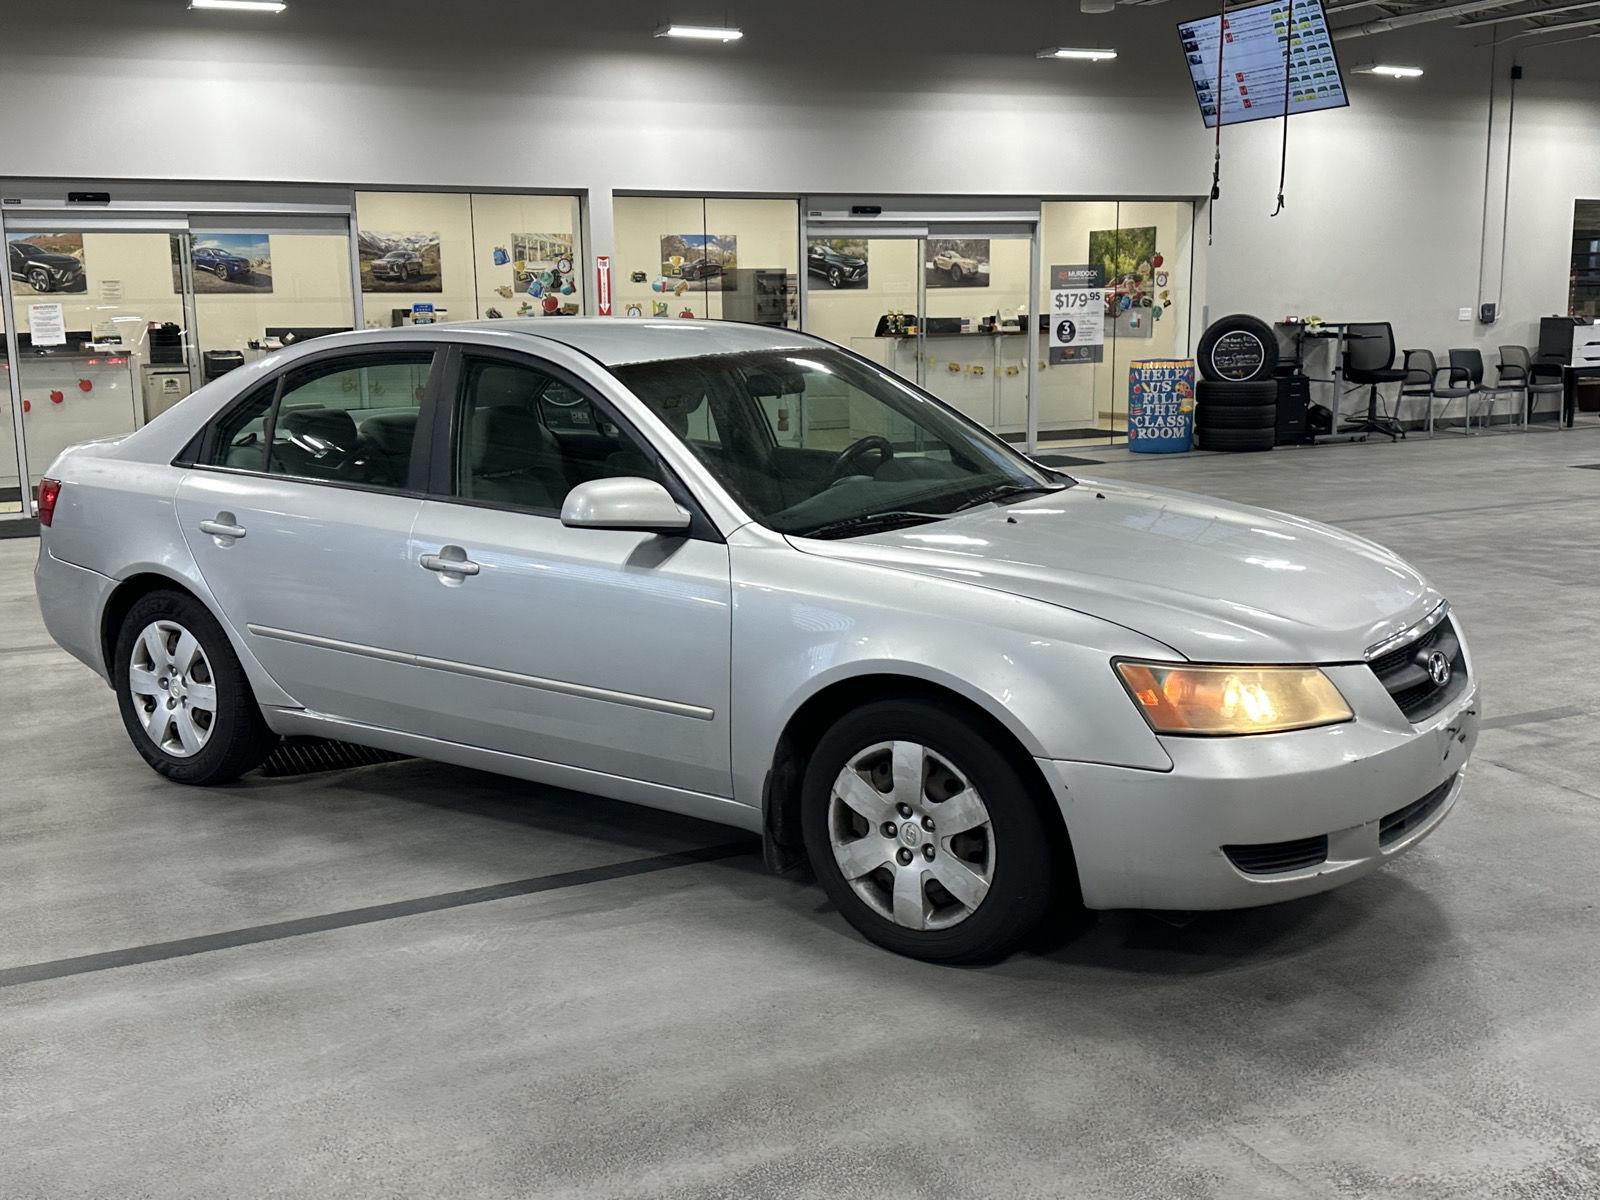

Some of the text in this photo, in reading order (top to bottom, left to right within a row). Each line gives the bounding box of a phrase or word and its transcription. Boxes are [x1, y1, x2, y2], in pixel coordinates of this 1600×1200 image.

[1062, 321, 1070, 335] 3
[1141, 369, 1184, 381] HELP
[1150, 380, 1172, 394] US
[1142, 392, 1182, 404] FILL
[1143, 404, 1178, 416] THE
[1135, 415, 1185, 428] CLASS
[1137, 427, 1185, 439] ROOM
